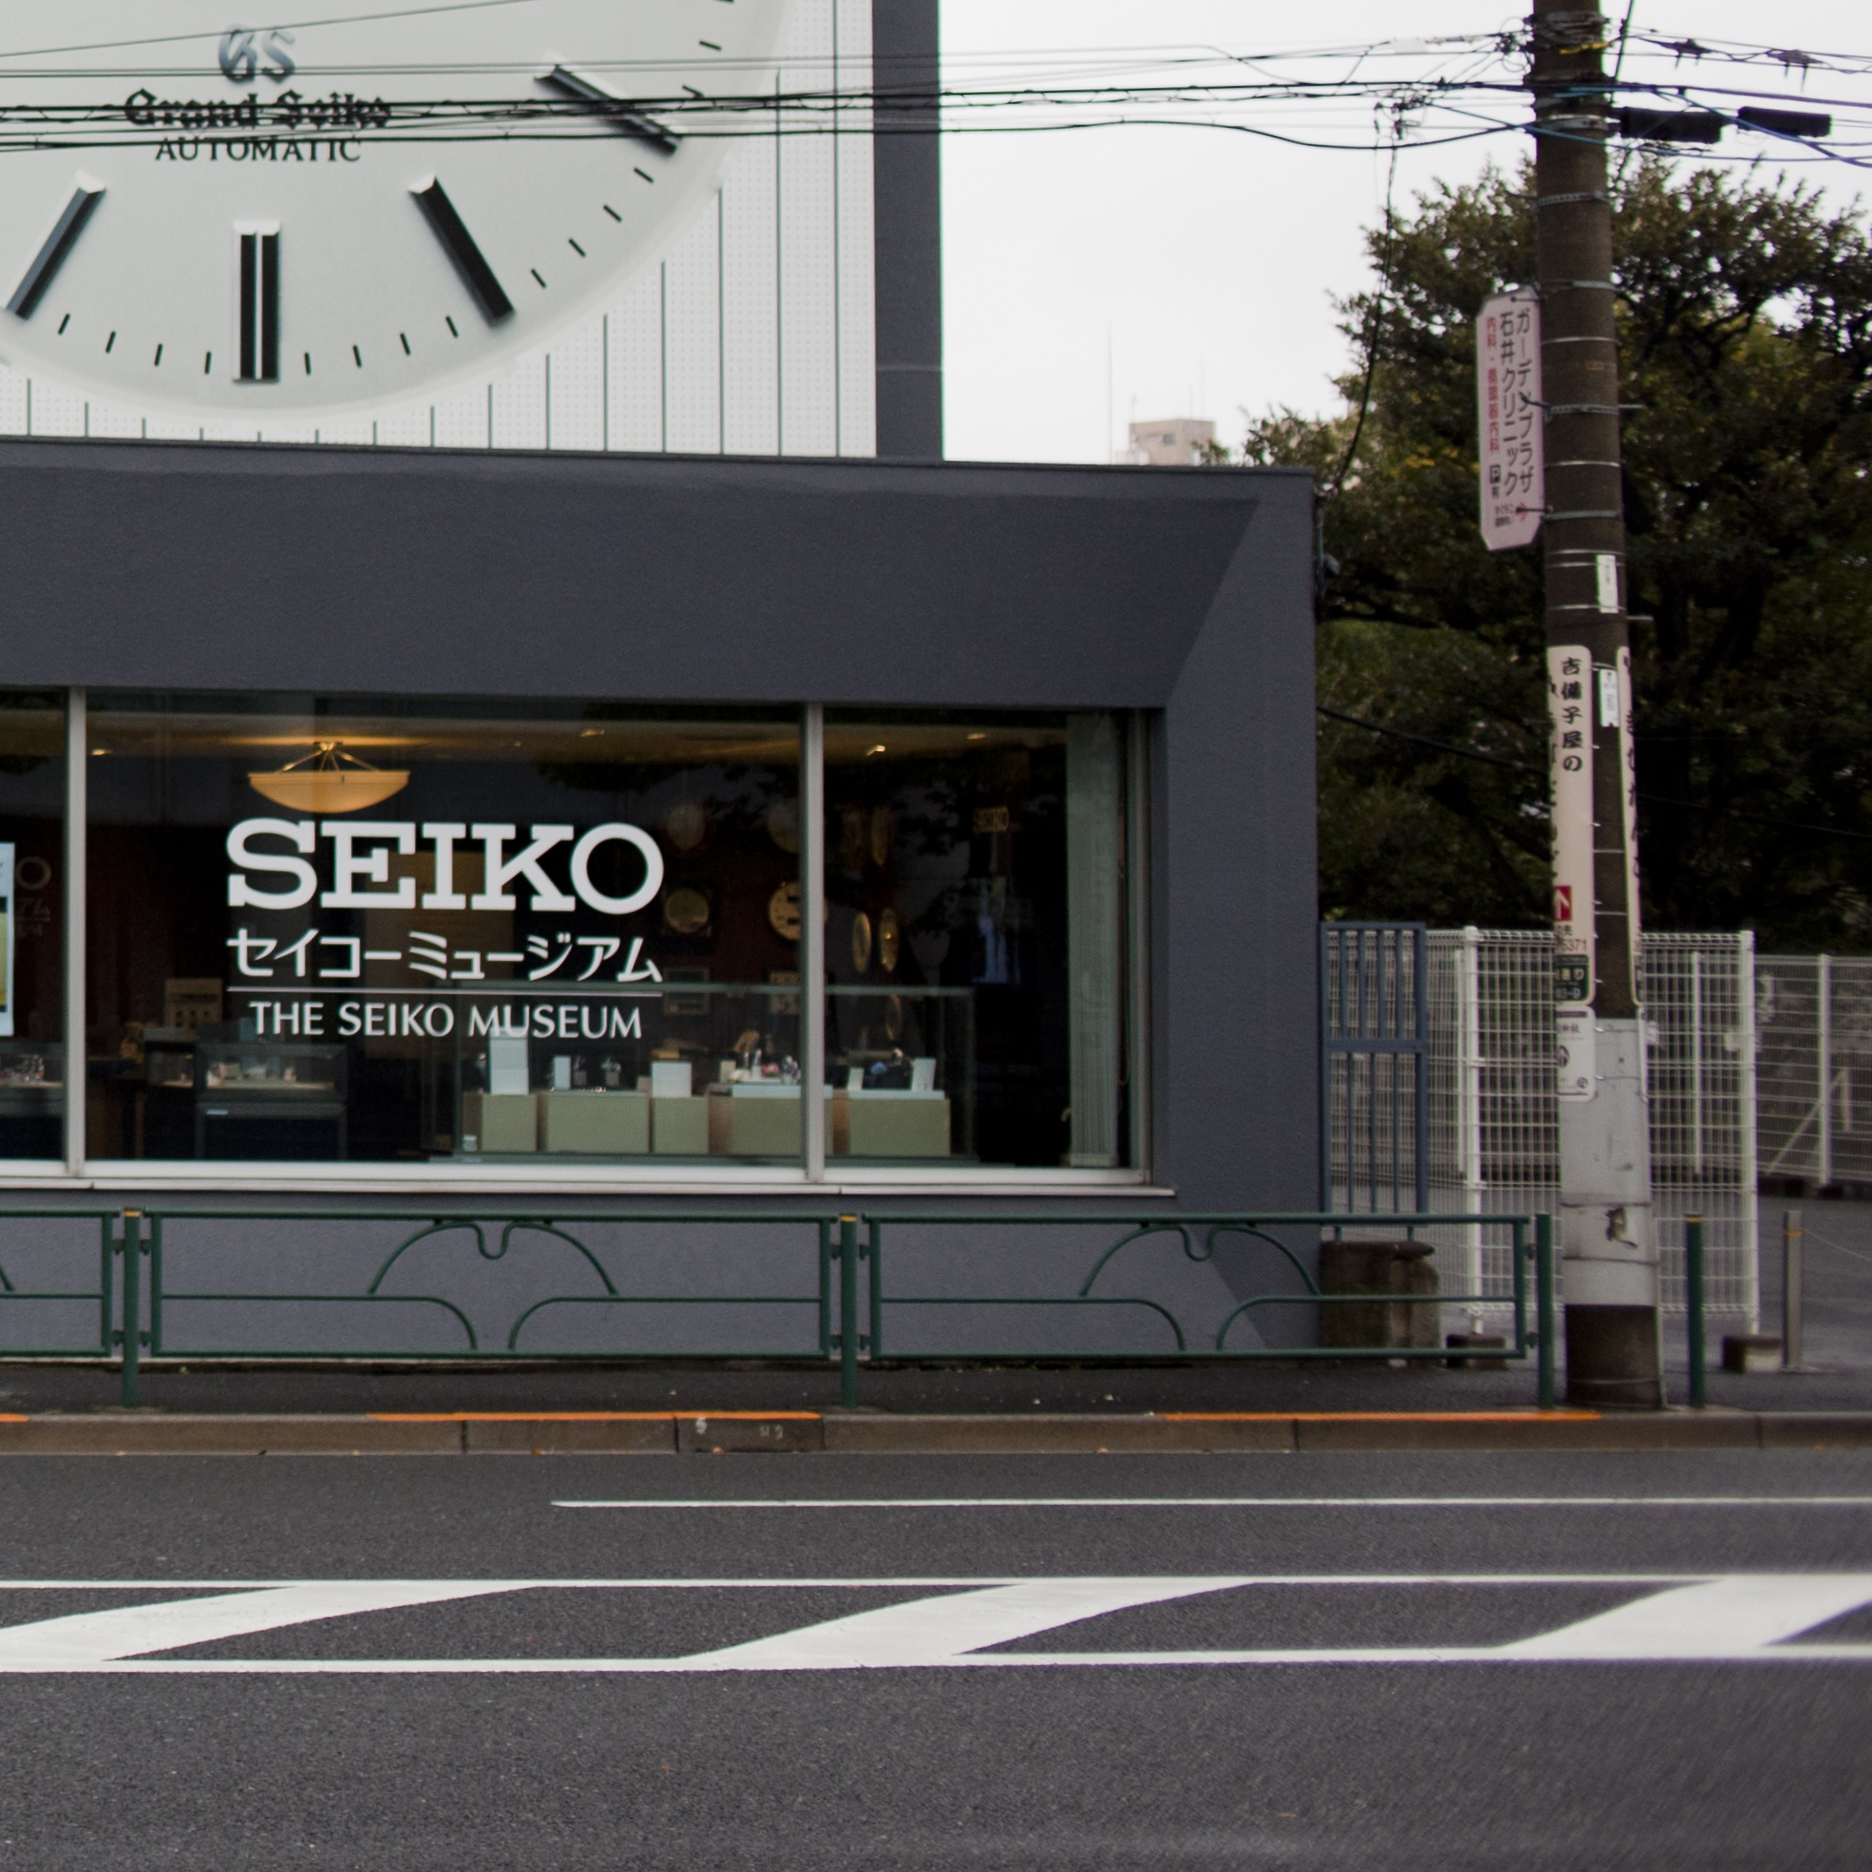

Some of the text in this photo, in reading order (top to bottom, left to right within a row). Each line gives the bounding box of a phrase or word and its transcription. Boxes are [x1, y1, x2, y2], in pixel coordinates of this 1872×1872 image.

[155, 137, 362, 162] AUTOMATIC
[1500, 311, 1520, 498] 石井クリニック
[1561, 657, 1584, 773] 吉備子屋の
[226, 818, 664, 914] SEIKO
[226, 928, 664, 983] セイコーミュージアム
[250, 1001, 643, 1040] THE SEIKO MUSEUM
